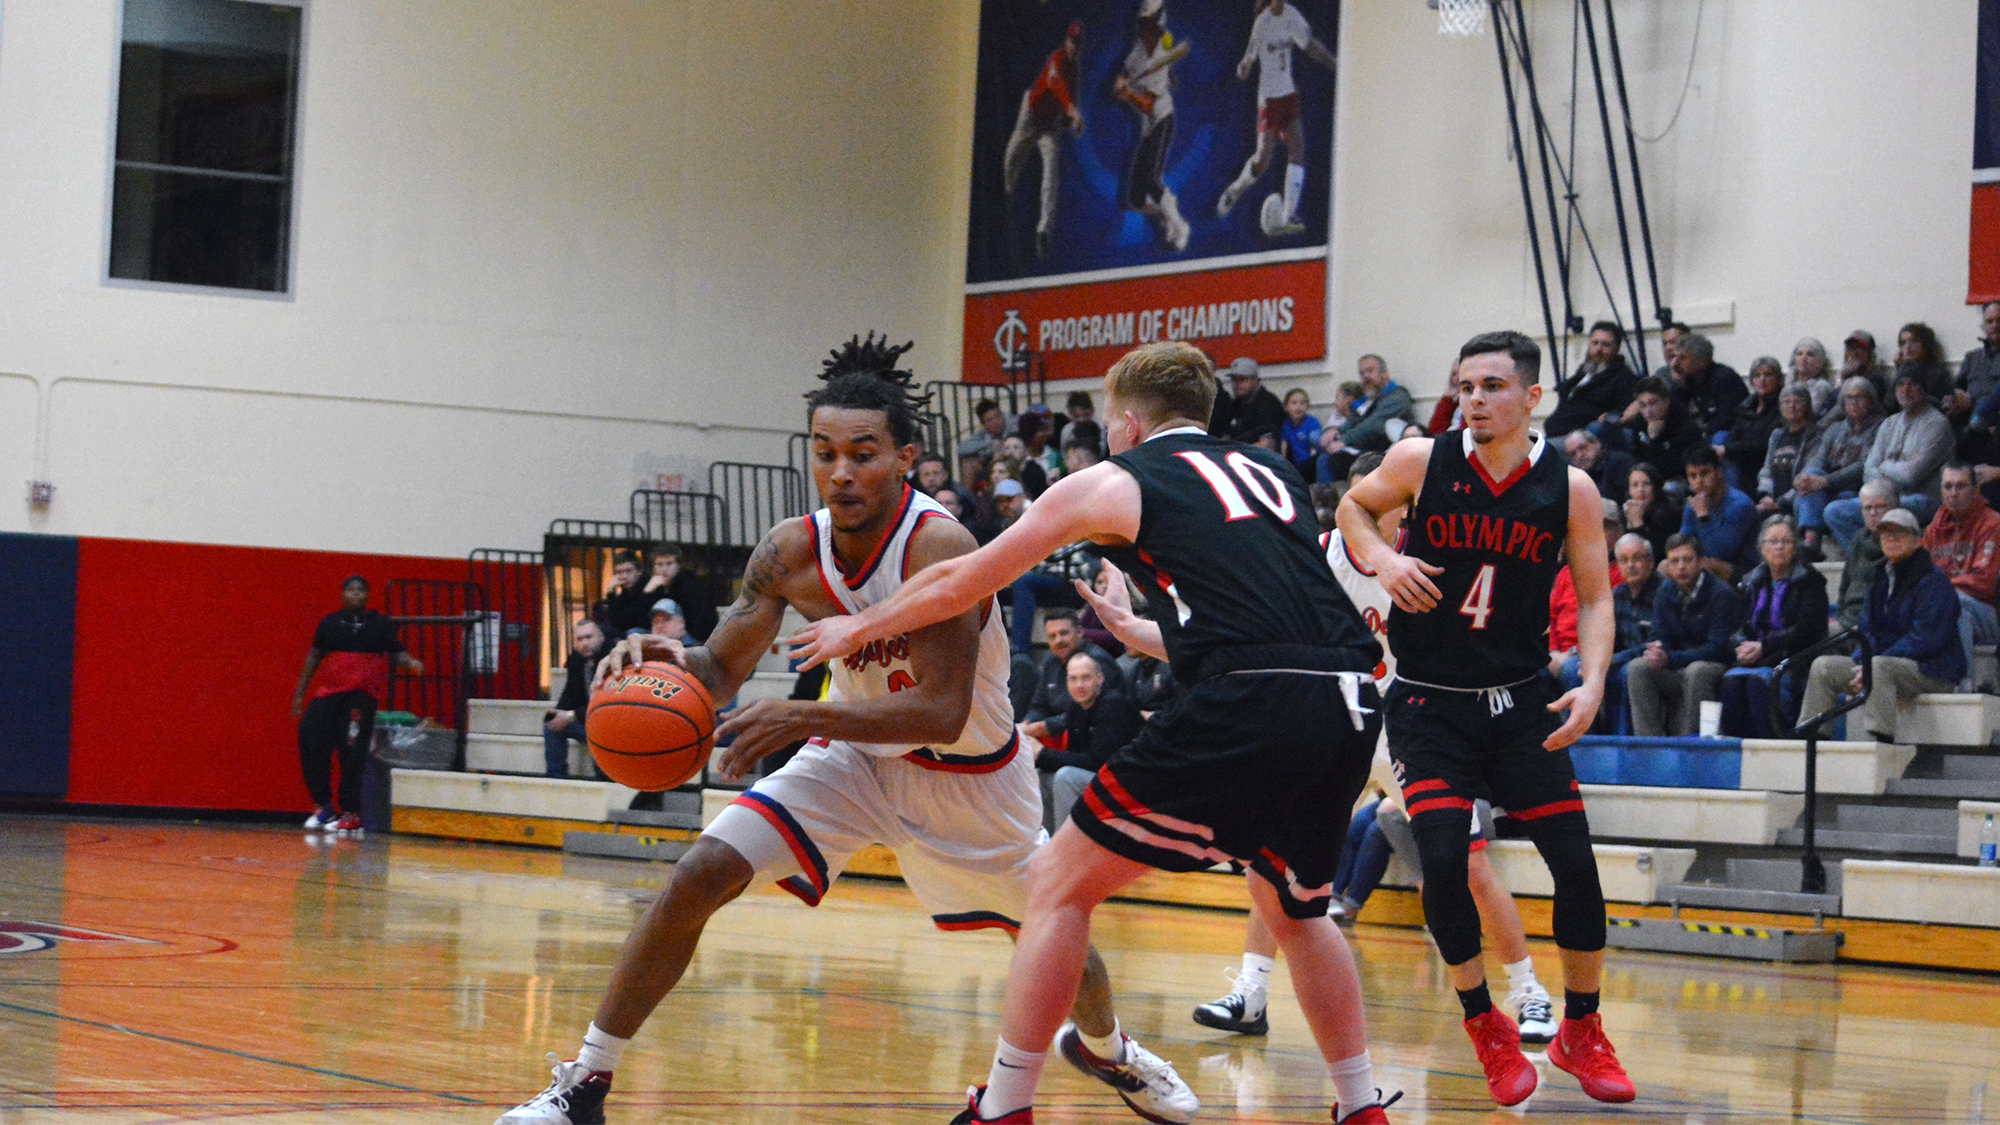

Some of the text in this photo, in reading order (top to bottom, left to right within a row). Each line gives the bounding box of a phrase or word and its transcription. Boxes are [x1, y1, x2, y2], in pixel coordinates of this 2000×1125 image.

[1039, 312, 1135, 351] PROGRAM
[1138, 308, 1164, 343] OF
[1167, 296, 1295, 341] CHAMPIONS
[1171, 450, 1297, 523] 10
[1426, 513, 1553, 563] OLYMPIC
[1458, 562, 1498, 631] 4
